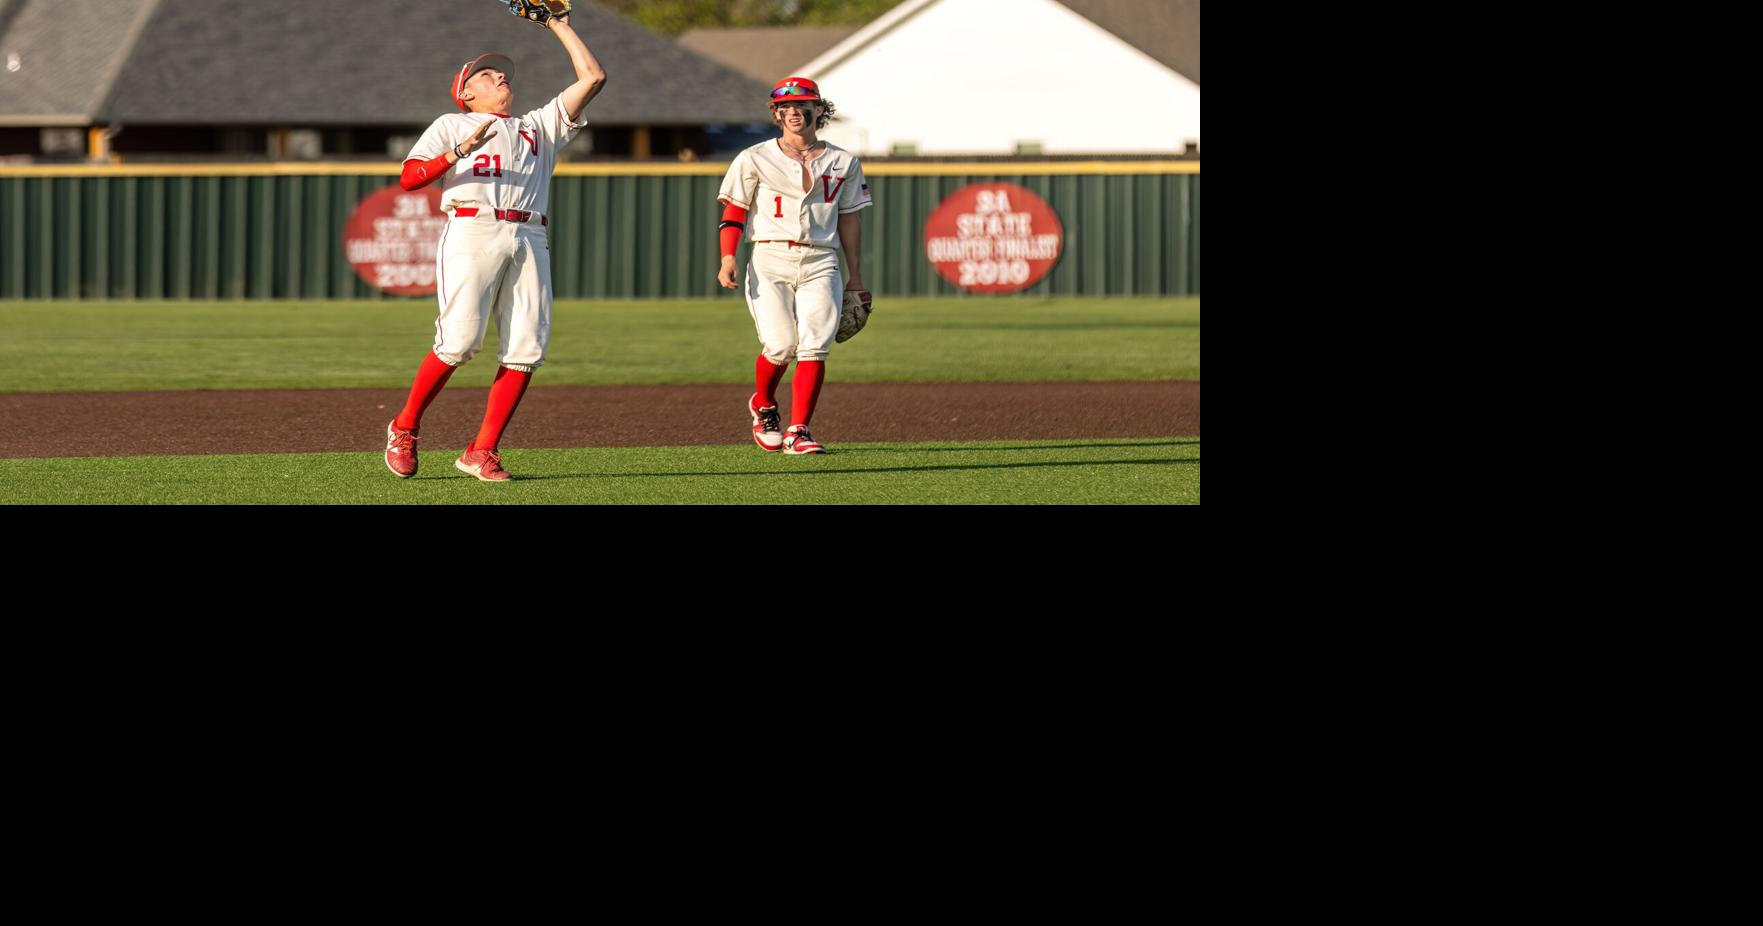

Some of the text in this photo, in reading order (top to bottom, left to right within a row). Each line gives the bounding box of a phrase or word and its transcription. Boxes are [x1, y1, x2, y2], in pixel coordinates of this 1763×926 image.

[473, 154, 503, 177] 21
[822, 175, 846, 204] V
[774, 196, 784, 218] 1
[956, 212, 1031, 237] STATE
[376, 264, 436, 286] 200
[958, 260, 1030, 285] 2010
